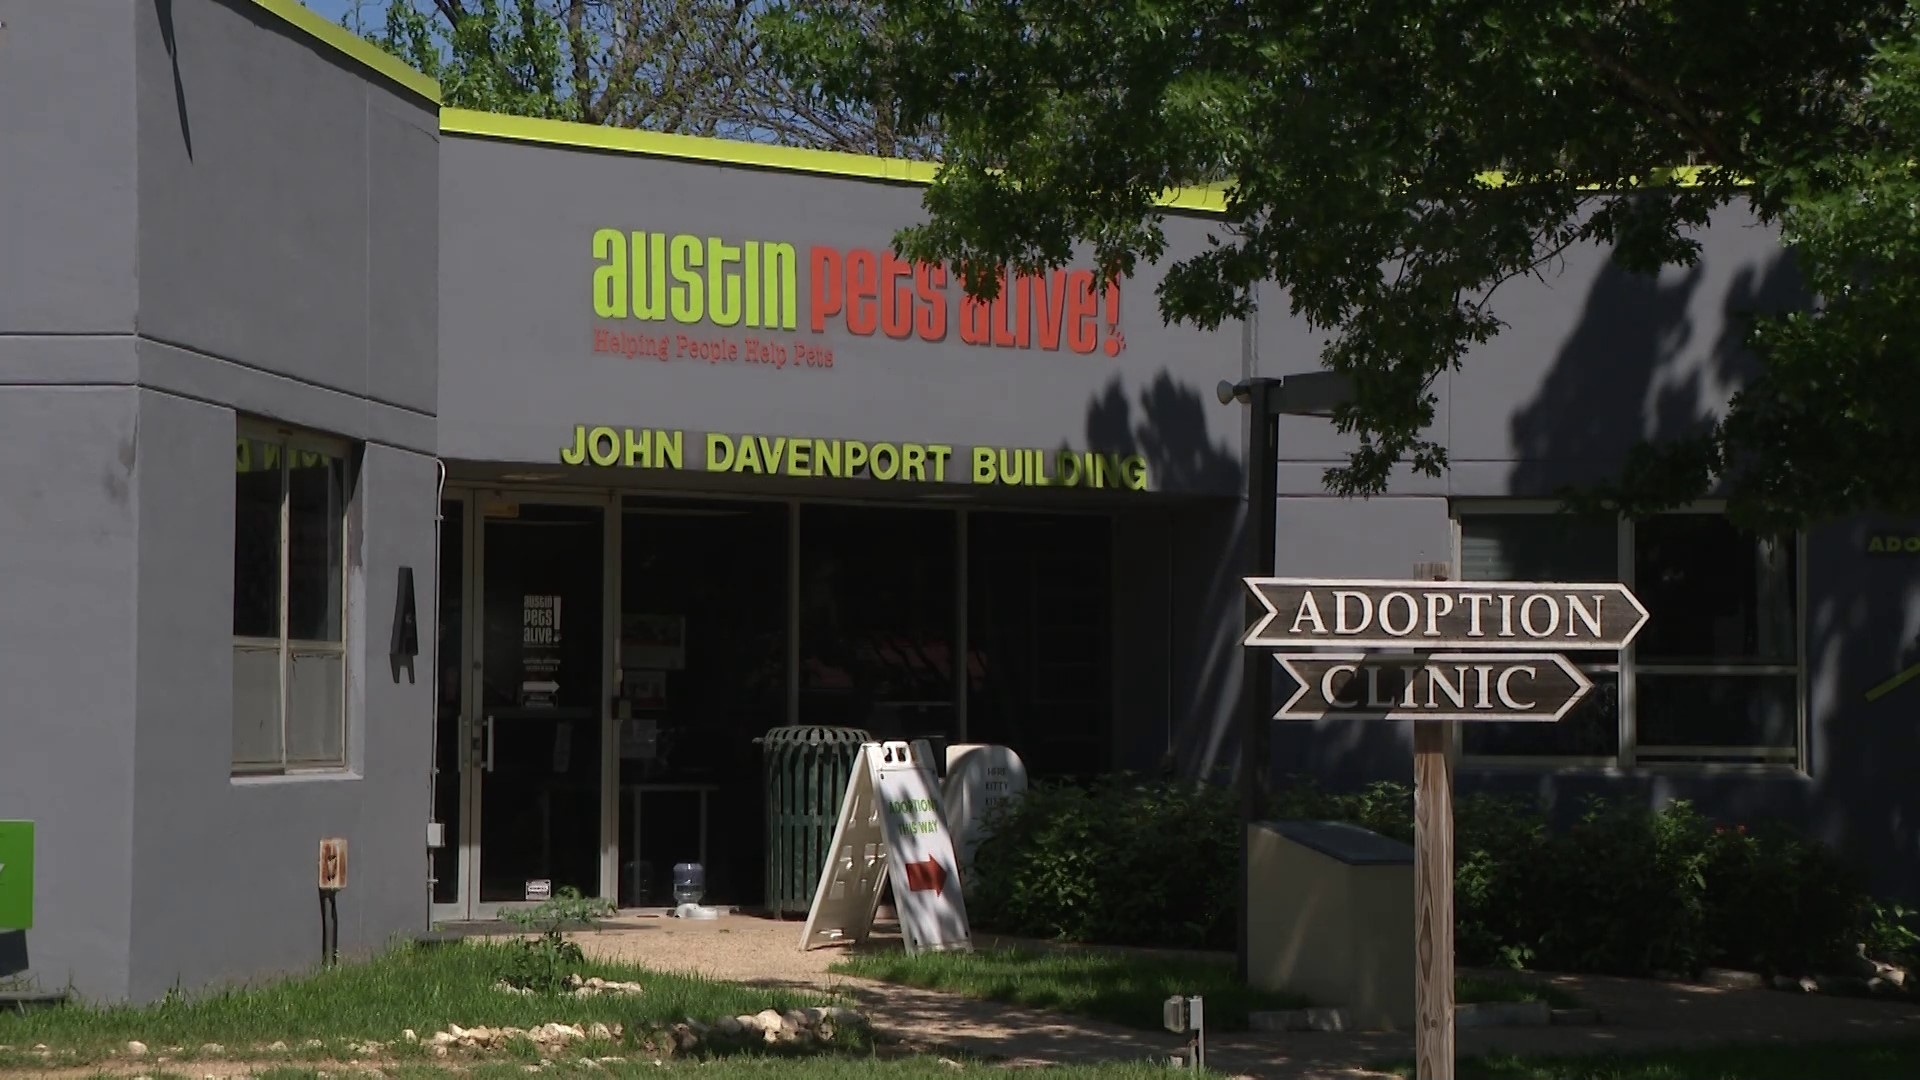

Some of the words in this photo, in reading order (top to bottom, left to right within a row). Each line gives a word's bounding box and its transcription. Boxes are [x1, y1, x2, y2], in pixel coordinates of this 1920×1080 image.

[592, 228, 798, 331] austin
[809, 246, 947, 342] pets
[593, 329, 669, 361] Helping
[676, 335, 738, 364] People
[745, 337, 787, 369] Help
[794, 343, 834, 369] Pets
[560, 424, 684, 470] JOHN
[706, 433, 951, 484] DAVENPORT
[972, 447, 1147, 491] BUILDING
[523, 609, 553, 626] pets
[1289, 590, 1605, 638] ADOPTION
[1320, 664, 1538, 710] CLINIC
[985, 782, 1008, 791] KITTY
[899, 821, 917, 835] THIS
[919, 819, 938, 834] WAY
